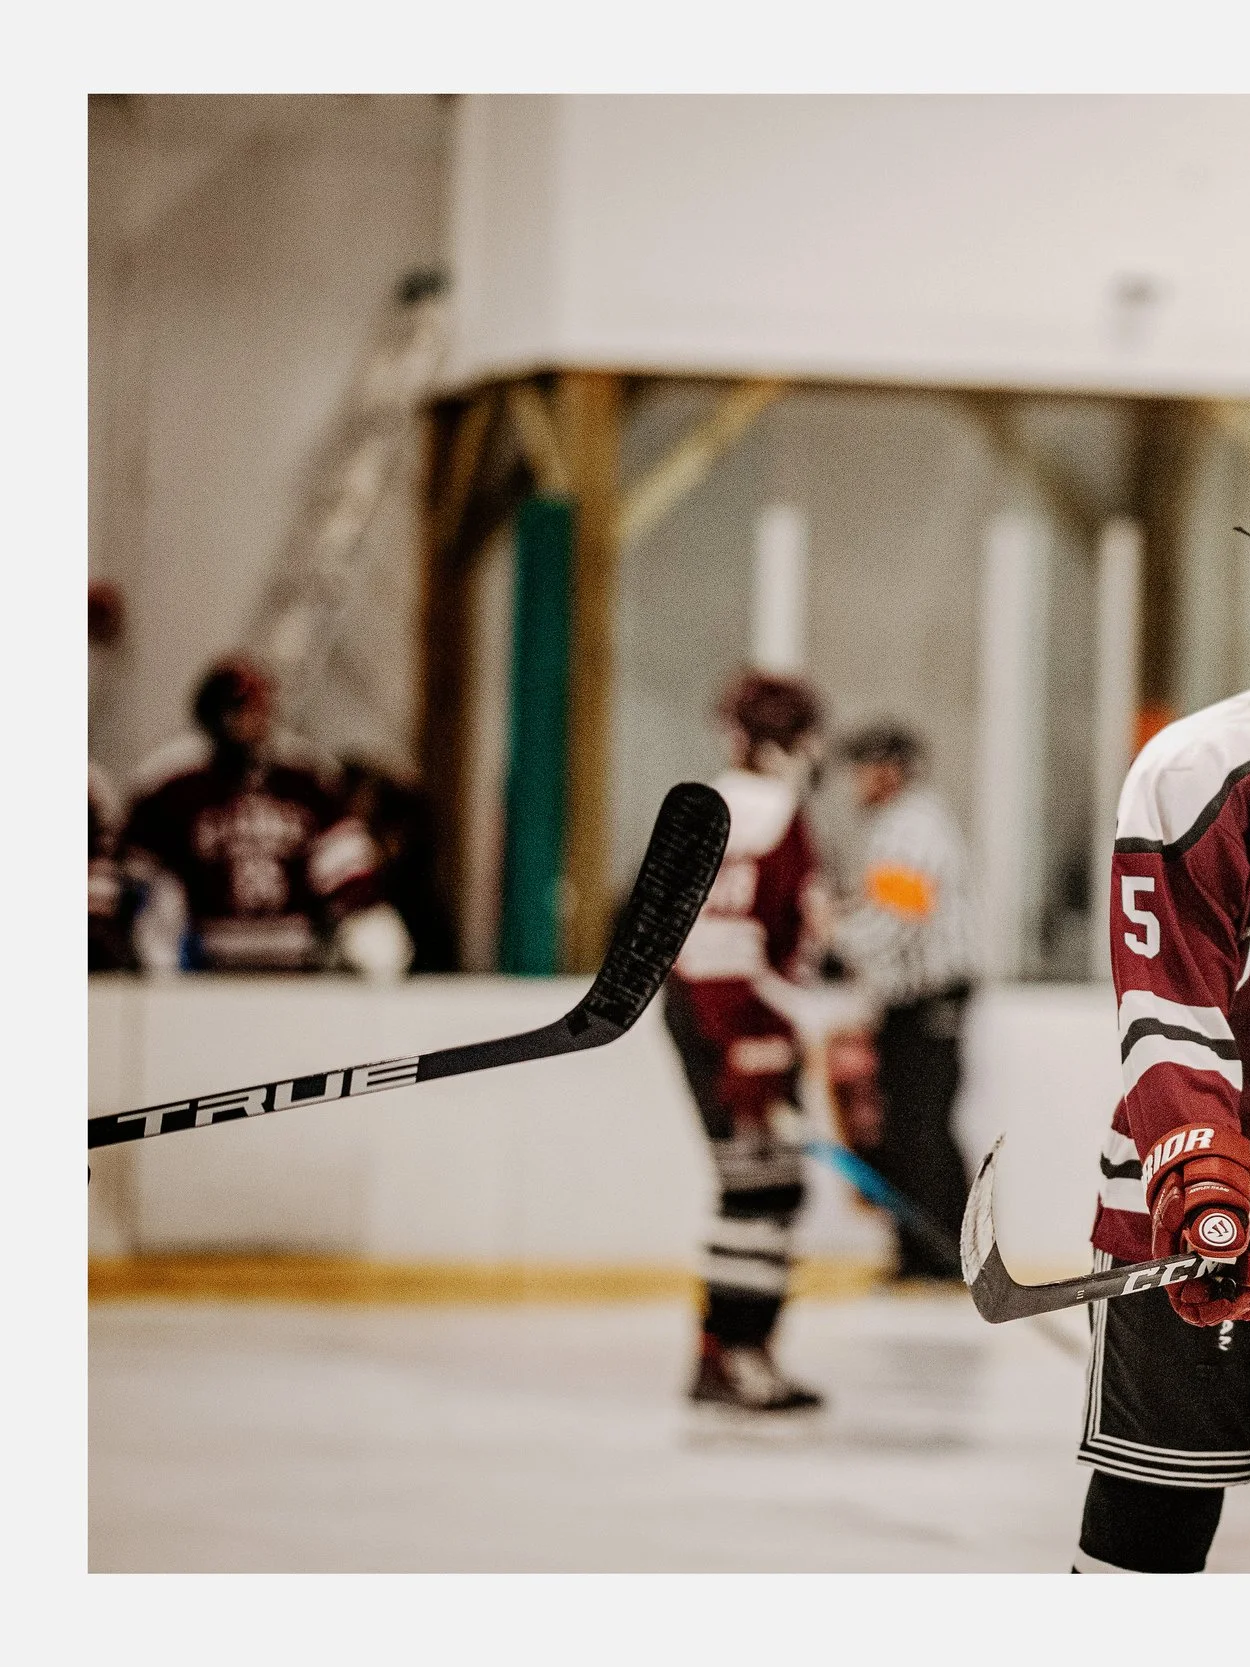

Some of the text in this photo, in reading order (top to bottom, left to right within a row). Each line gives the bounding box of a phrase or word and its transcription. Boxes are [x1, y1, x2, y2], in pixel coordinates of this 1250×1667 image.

[1121, 876, 1161, 959] 5
[117, 1056, 420, 1138] TRUE
[1142, 1127, 1215, 1185] RIOR
